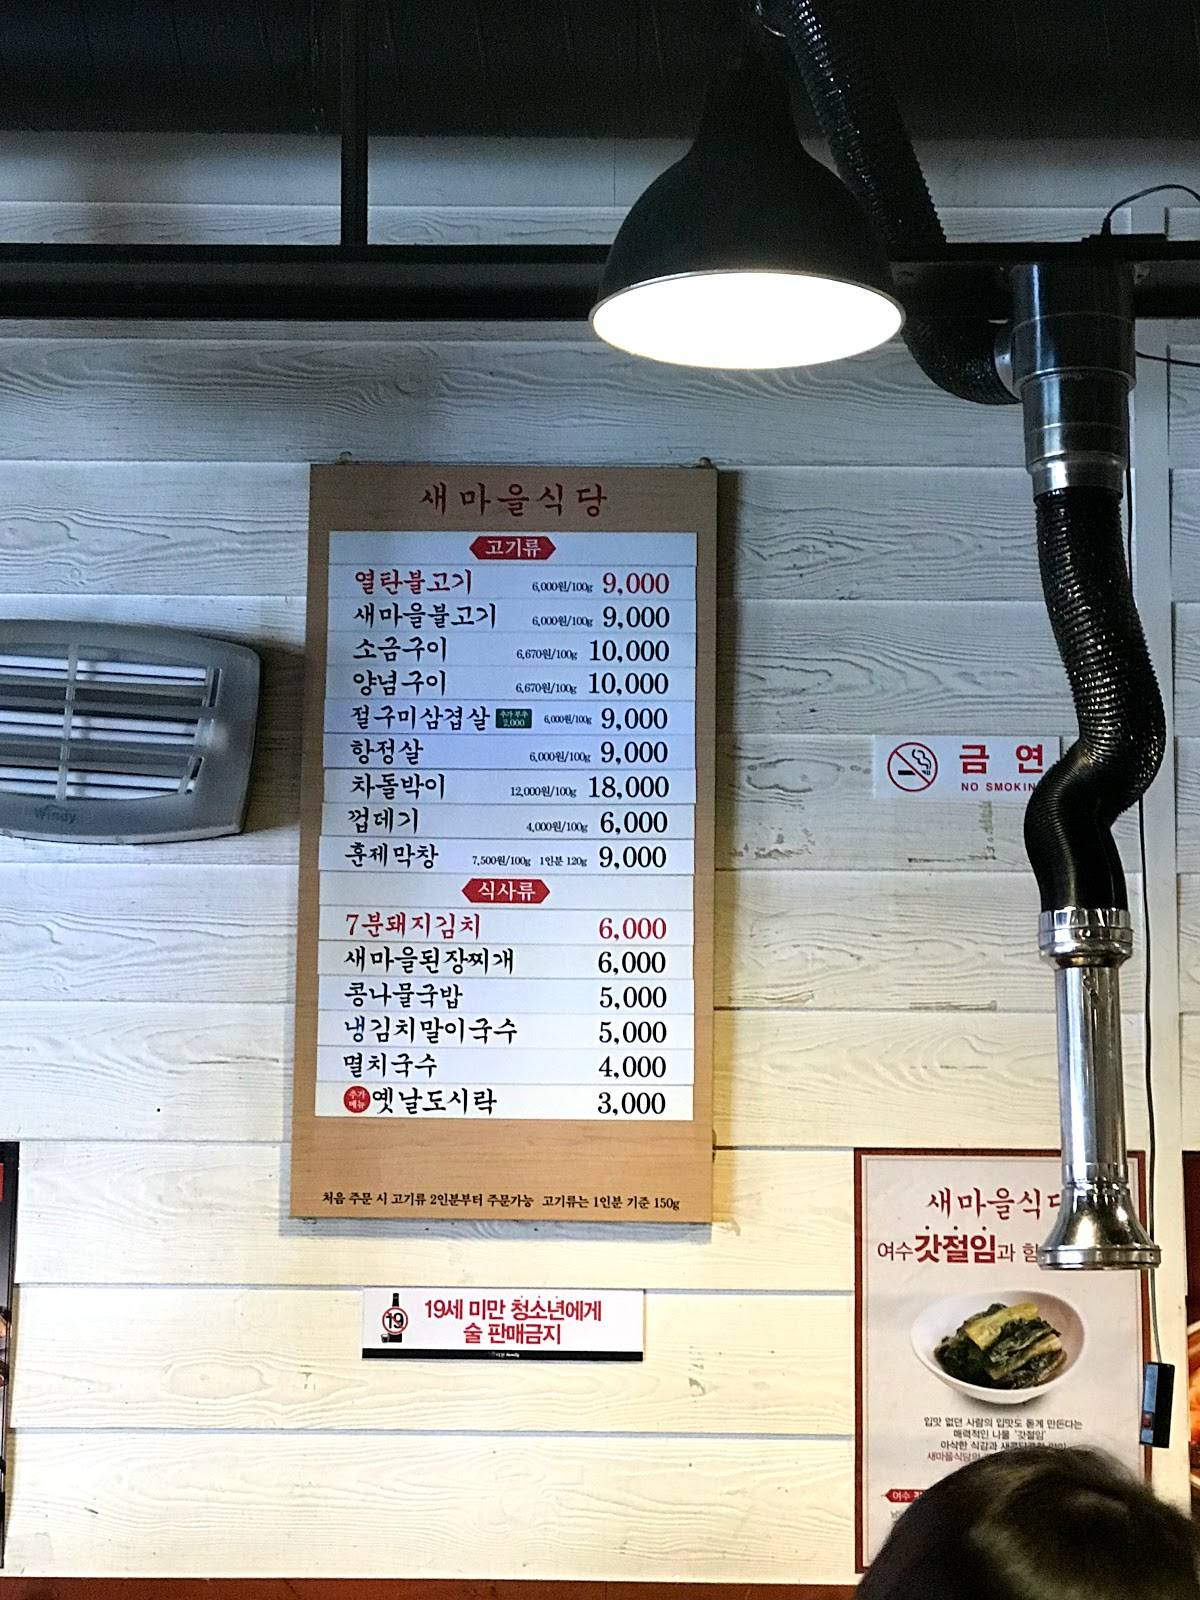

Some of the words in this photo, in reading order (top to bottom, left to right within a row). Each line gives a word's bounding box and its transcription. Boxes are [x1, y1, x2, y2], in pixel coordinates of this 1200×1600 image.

[485, 538, 542, 558] 고기류
[355, 569, 471, 595] 열탄불고기
[531, 581, 592, 592] 6,000원/100g
[603, 573, 669, 595] 9,000
[353, 602, 495, 629] 새마을불고기
[532, 616, 592, 627] 6,000원/100g
[603, 606, 669, 629] 9,000
[353, 636, 446, 662] 소금구이
[516, 649, 577, 660] 6,670원/100g
[590, 640, 669, 663] 10,000
[353, 670, 445, 696] 양념구이
[515, 682, 576, 694] 6,670원/100g
[589, 673, 668, 695] 10,000
[350, 705, 490, 731] 절구미삼겹살
[543, 714, 592, 724] 6,000원/100g
[602, 708, 667, 731] 9,000
[350, 738, 423, 765] 항정살
[529, 751, 590, 762] 6,000원/100g
[601, 742, 668, 765] 9,000
[959, 745, 989, 774] 금
[1016, 744, 1043, 773] 연
[351, 773, 444, 800] 차돌박이
[511, 786, 576, 798] 12,000원/100g
[589, 776, 669, 799] 18,000
[962, 783, 978, 791] NO
[986, 782, 1036, 792] SMOKIN
[348, 807, 417, 833] 껍데기
[526, 821, 588, 832] 4,000원/100g
[601, 812, 667, 834] 6,000
[345, 842, 438, 869] 훈제막창
[472, 856, 531, 866] 7,500원/100g
[540, 856, 563, 866] 1인분
[567, 857, 587, 866] 120g
[600, 846, 666, 869] 9,000
[478, 880, 536, 901] 식사류
[346, 912, 479, 939] 7분돼지김치
[599, 918, 666, 940] 6,000
[344, 946, 513, 974] 새마을된장찌개
[599, 952, 665, 974] 6,000
[345, 982, 463, 1009] 콩나물국밥
[600, 987, 666, 1009] 5,000
[345, 1015, 517, 1044] 냉김치말이국수
[599, 1022, 666, 1044] 5,000
[344, 1052, 437, 1078] 멸치국수
[599, 1056, 666, 1078] 4,000
[373, 1087, 497, 1115] 옛날도시락
[598, 1092, 665, 1115] 3,000
[321, 1192, 347, 1205] 처음
[348, 1193, 373, 1205] 주문
[375, 1192, 388, 1205] 시
[390, 1192, 427, 1206] 고기류
[429, 1193, 483, 1206] 2인분부터
[486, 1194, 535, 1207] 주문가능
[541, 1195, 590, 1208] 고기류는
[593, 1196, 623, 1208] 1인분
[626, 1196, 651, 1209] 기준
[654, 1198, 681, 1211] 150g
[386, 1312, 404, 1329] 19
[425, 1299, 463, 1319] 19세
[470, 1299, 505, 1320] 미만
[511, 1300, 601, 1321] 청소년에게
[464, 1323, 482, 1343] 술
[488, 1323, 560, 1344] 판매금지
